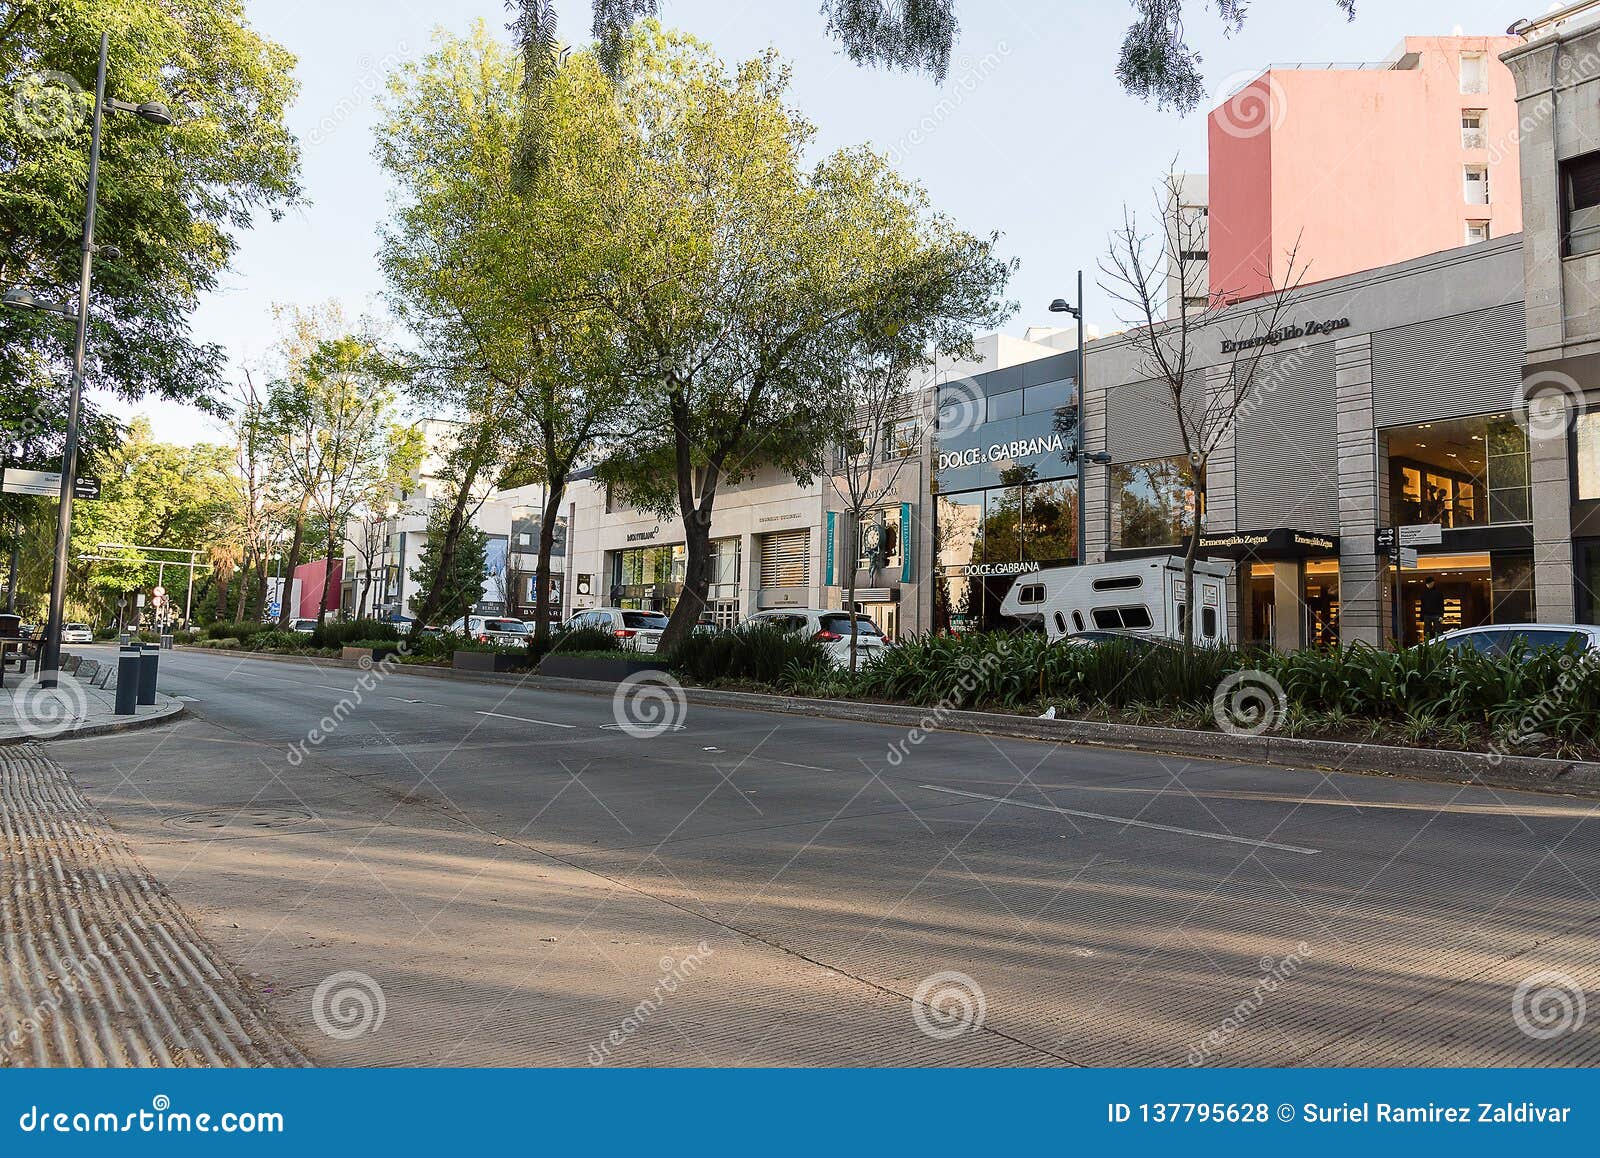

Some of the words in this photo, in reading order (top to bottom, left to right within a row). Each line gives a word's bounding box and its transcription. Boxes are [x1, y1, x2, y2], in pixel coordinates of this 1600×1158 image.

[1220, 324, 1304, 353] Ermenegildo
[1305, 317, 1350, 337] Zegna
[1199, 536, 1244, 547] Ermenegildo
[1244, 535, 1268, 545] Zegna
